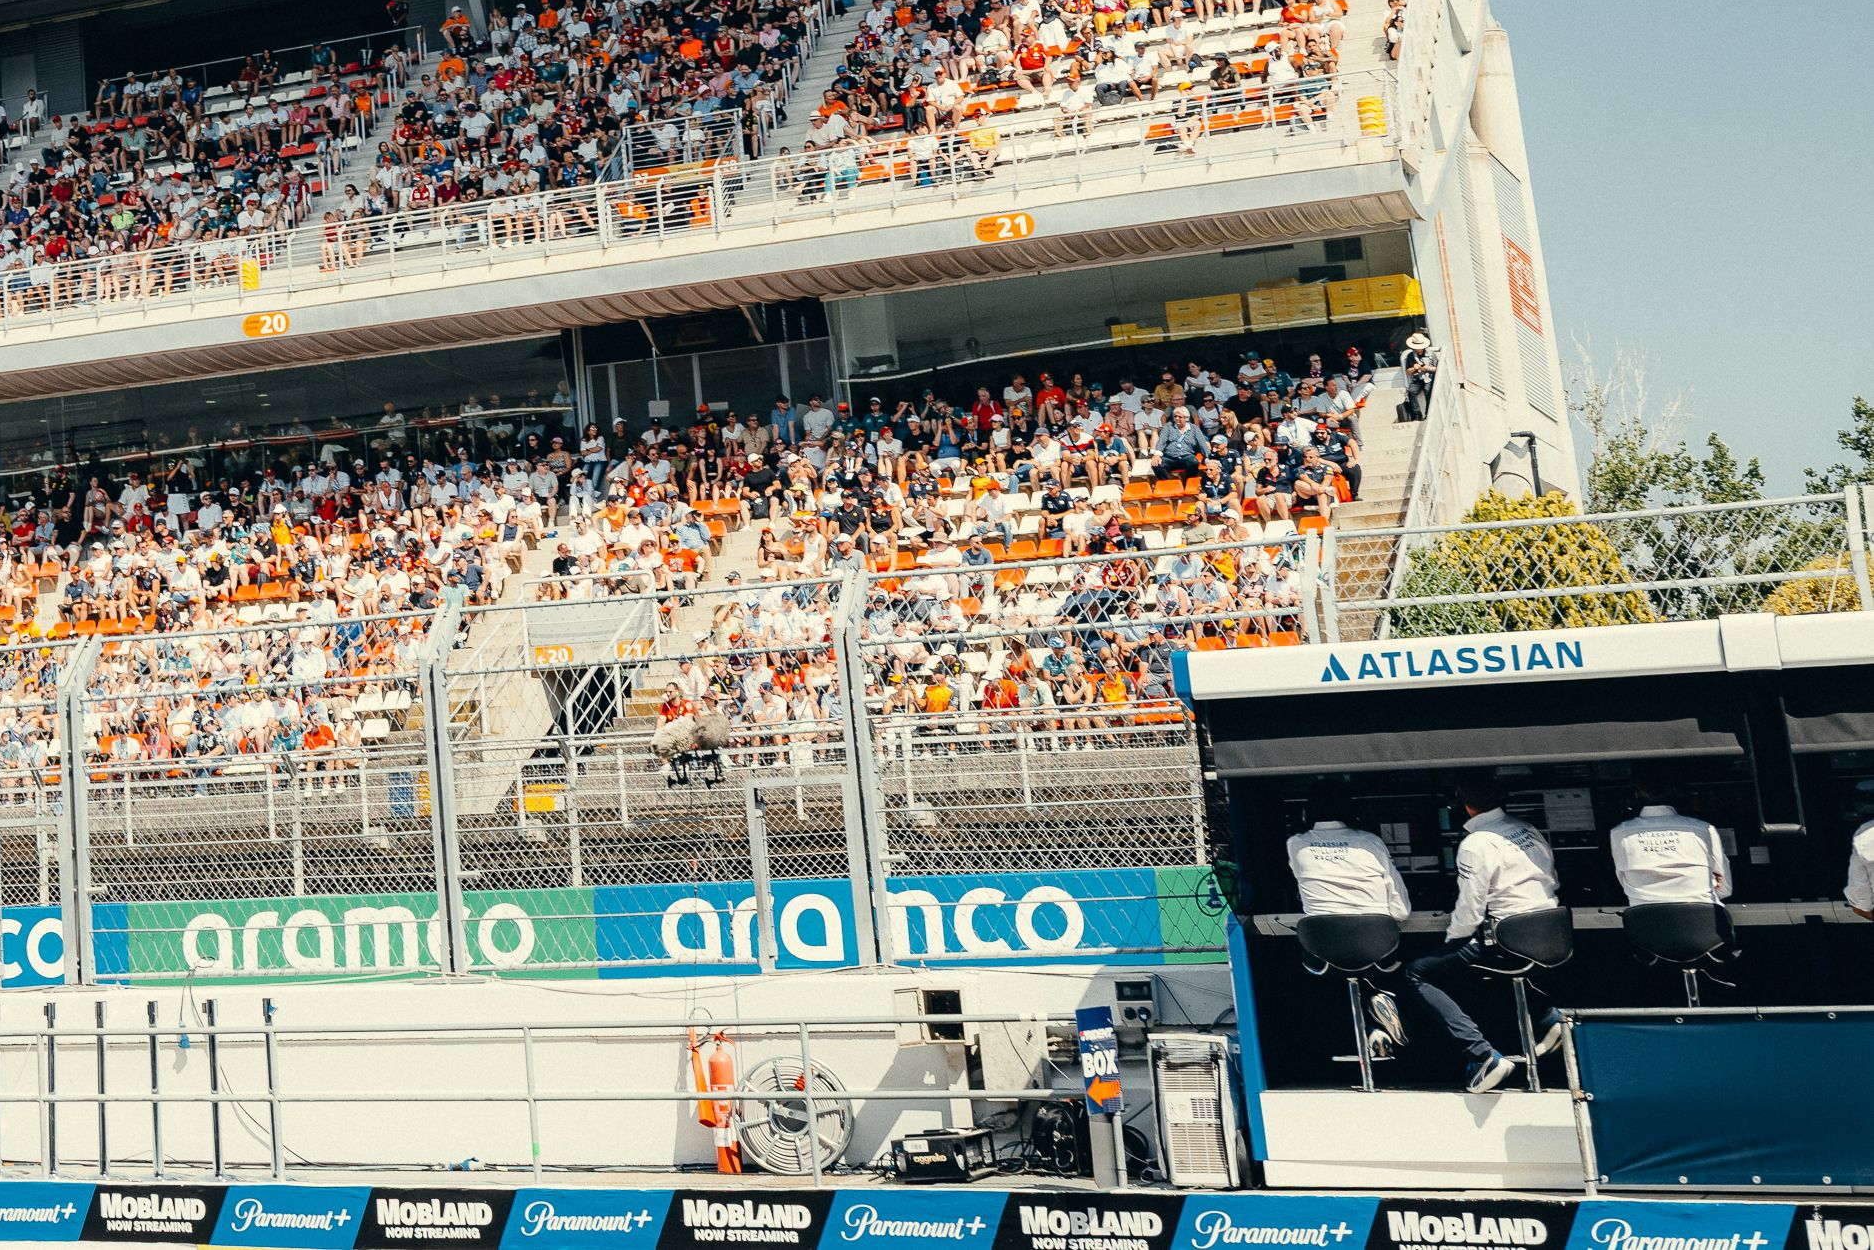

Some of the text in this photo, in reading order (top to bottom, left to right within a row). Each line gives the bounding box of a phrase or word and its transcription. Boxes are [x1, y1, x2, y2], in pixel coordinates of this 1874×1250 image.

[997, 215, 1028, 238] 21
[260, 313, 287, 334] 20
[548, 648, 569, 664] 20
[1358, 641, 1584, 680] ATLASSIAN
[1081, 1049, 1119, 1078] BOX
[912, 1152, 948, 1165] aggreko
[100, 1193, 206, 1221] MOBLAND
[231, 1198, 352, 1232] Paramount+
[376, 1198, 493, 1227] MOBLAND
[521, 1201, 653, 1237] Paramount+
[682, 1199, 812, 1230] MOBLAND
[1019, 1206, 1163, 1238] MOBLAND
[840, 1204, 987, 1242] Paramount+
[1192, 1210, 1353, 1249] Paramount+
[1387, 1210, 1548, 1246] MOBLAND
[1805, 1219, 1874, 1250] MO
[1032, 1237, 1067, 1250] NOW
